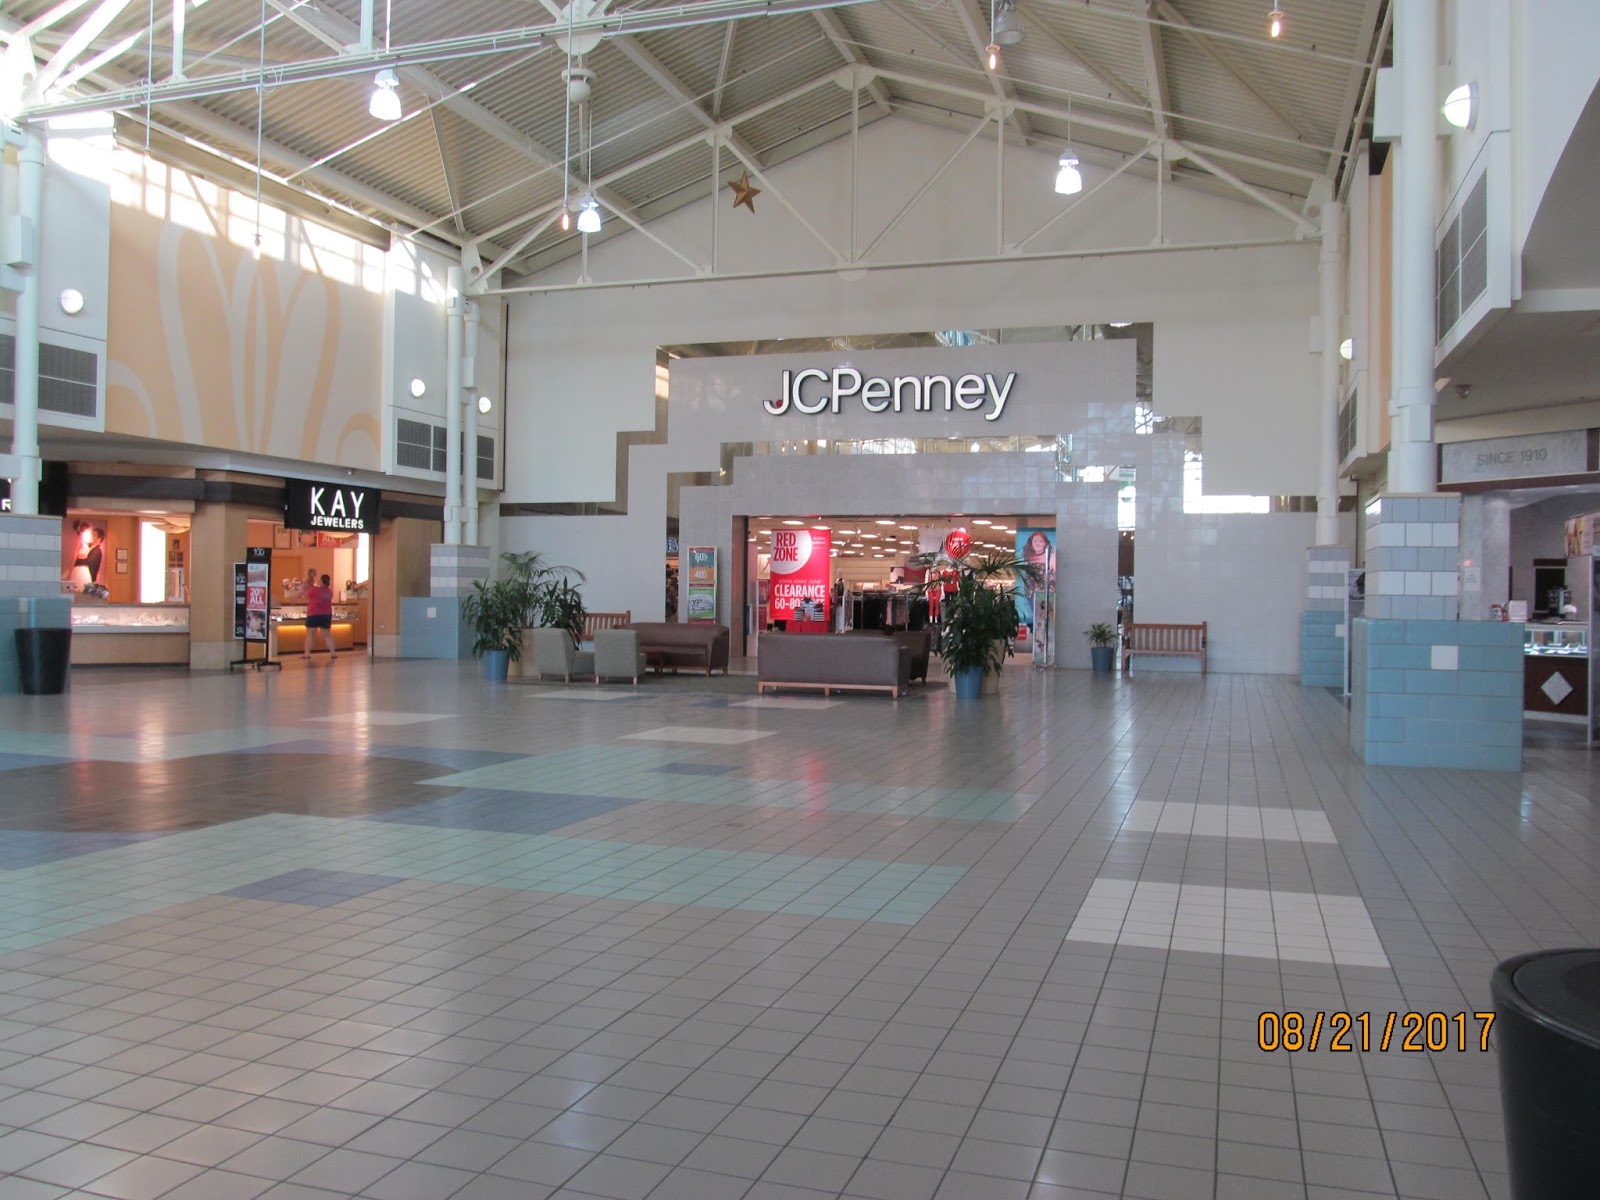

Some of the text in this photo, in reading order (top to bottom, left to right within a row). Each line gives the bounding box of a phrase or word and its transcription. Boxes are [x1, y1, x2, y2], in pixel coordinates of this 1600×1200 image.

[763, 368, 1017, 421] JCPenney
[1476, 448, 1548, 466] SINCE 1910
[310, 486, 365, 518] KAY
[310, 515, 364, 530] JEWELERS
[776, 532, 796, 547] RED
[773, 547, 798, 562] ZONE
[774, 584, 826, 598] CLEARANCE
[250, 595, 264, 605] ALL
[774, 598, 803, 610] 60-80
